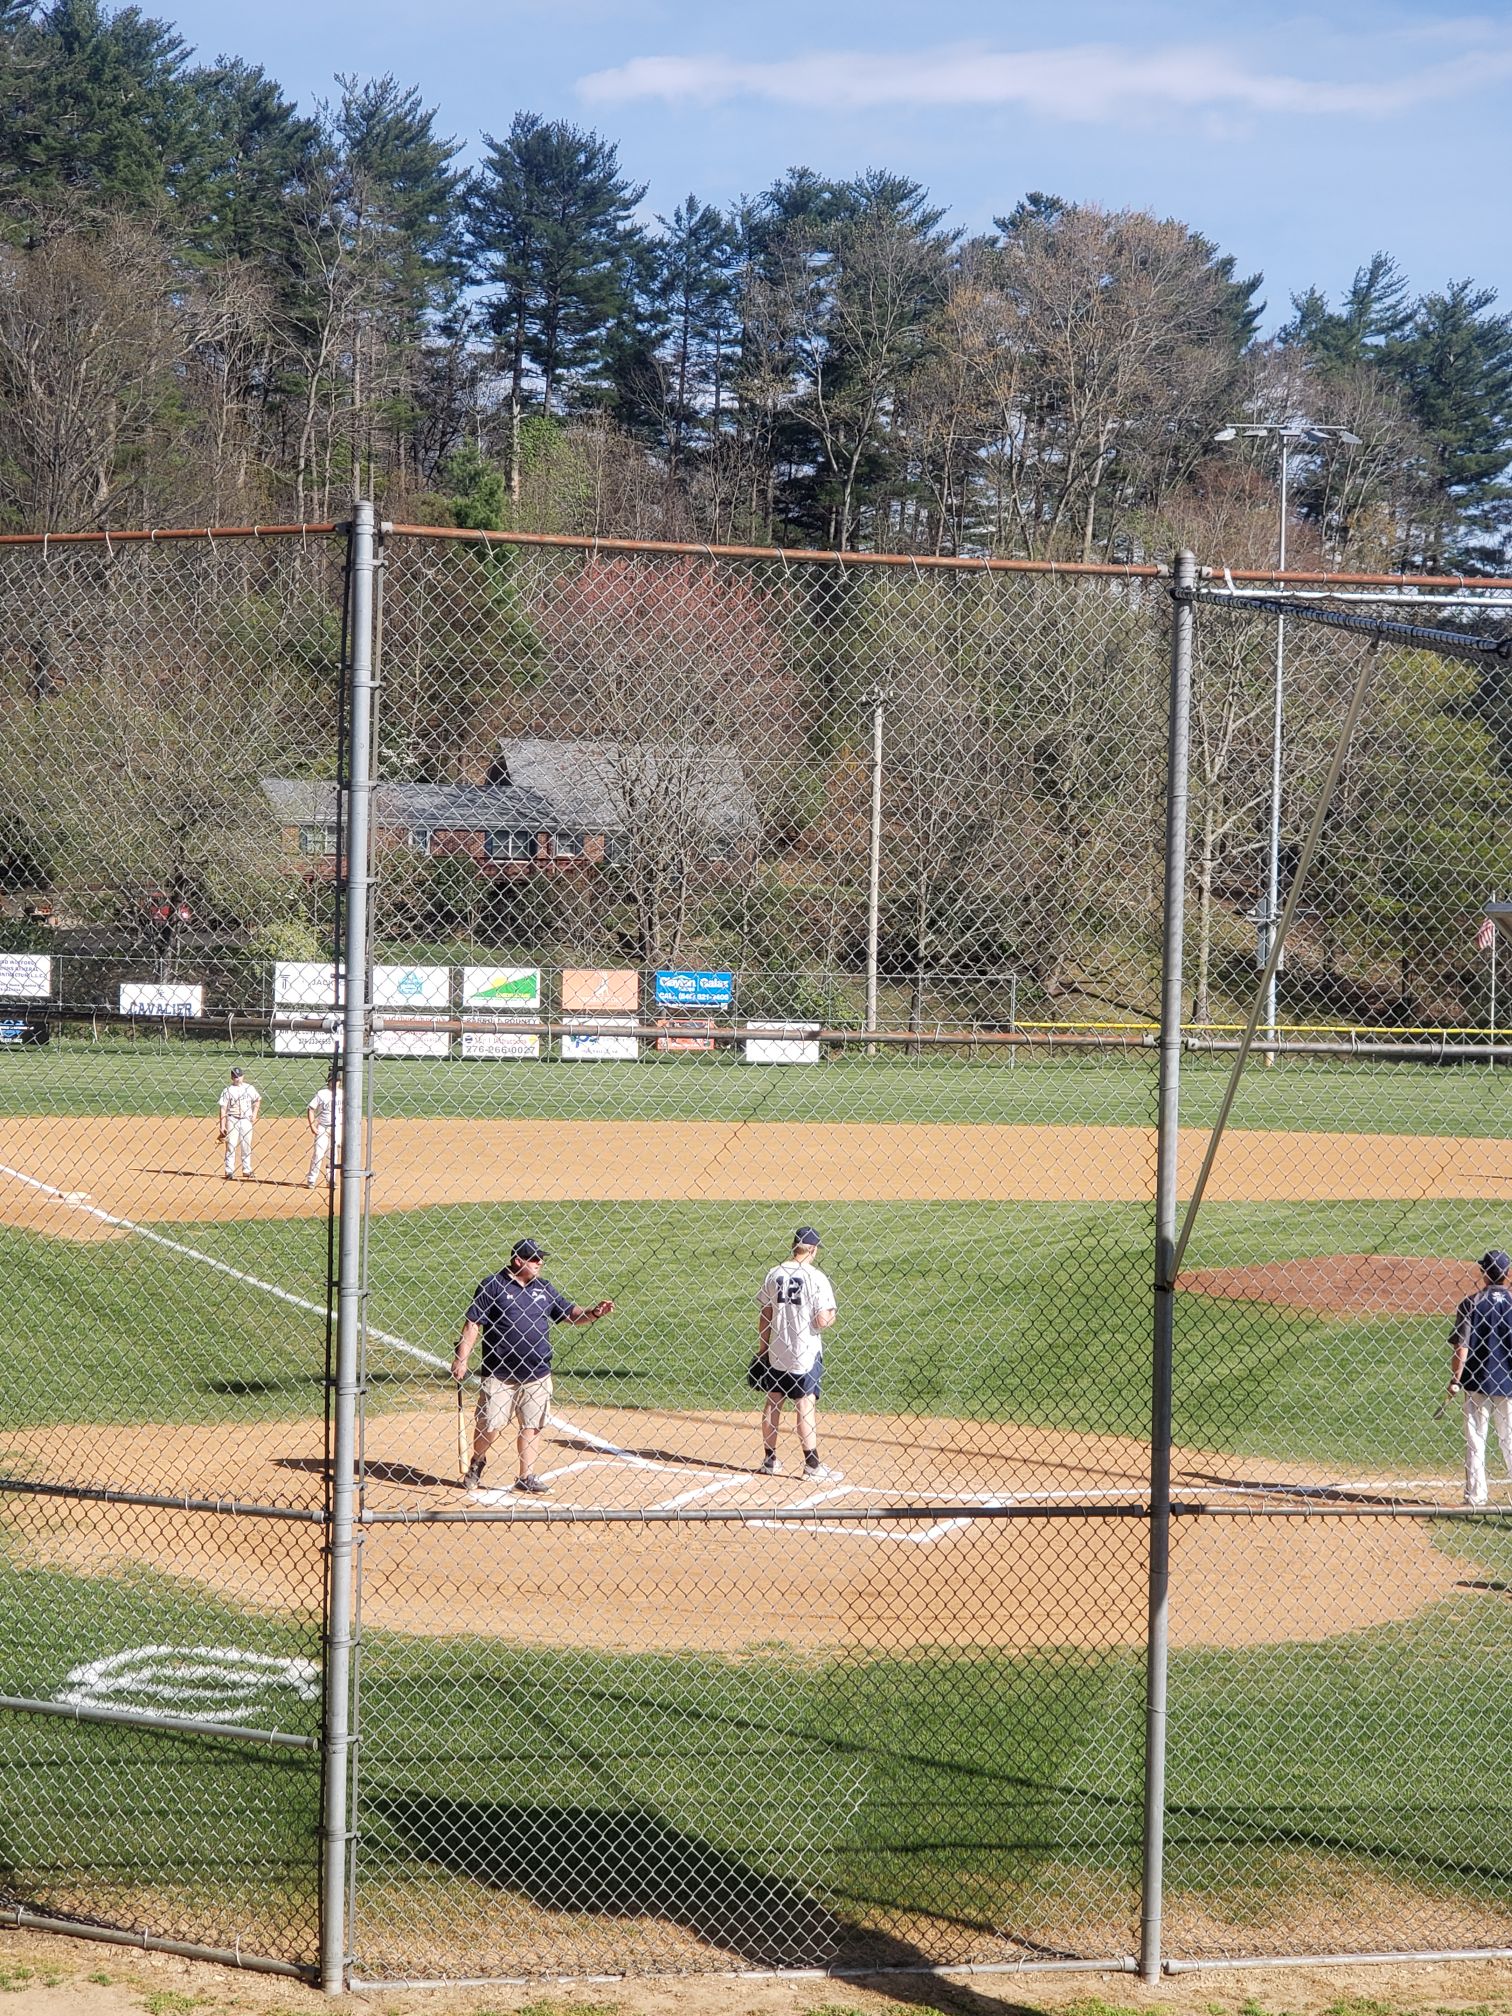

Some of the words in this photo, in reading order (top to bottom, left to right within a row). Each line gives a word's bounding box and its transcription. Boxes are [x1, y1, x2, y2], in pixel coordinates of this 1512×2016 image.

[659, 976, 696, 989] Clayton
[699, 977, 729, 989] Galax
[776, 1276, 804, 1305] 12
